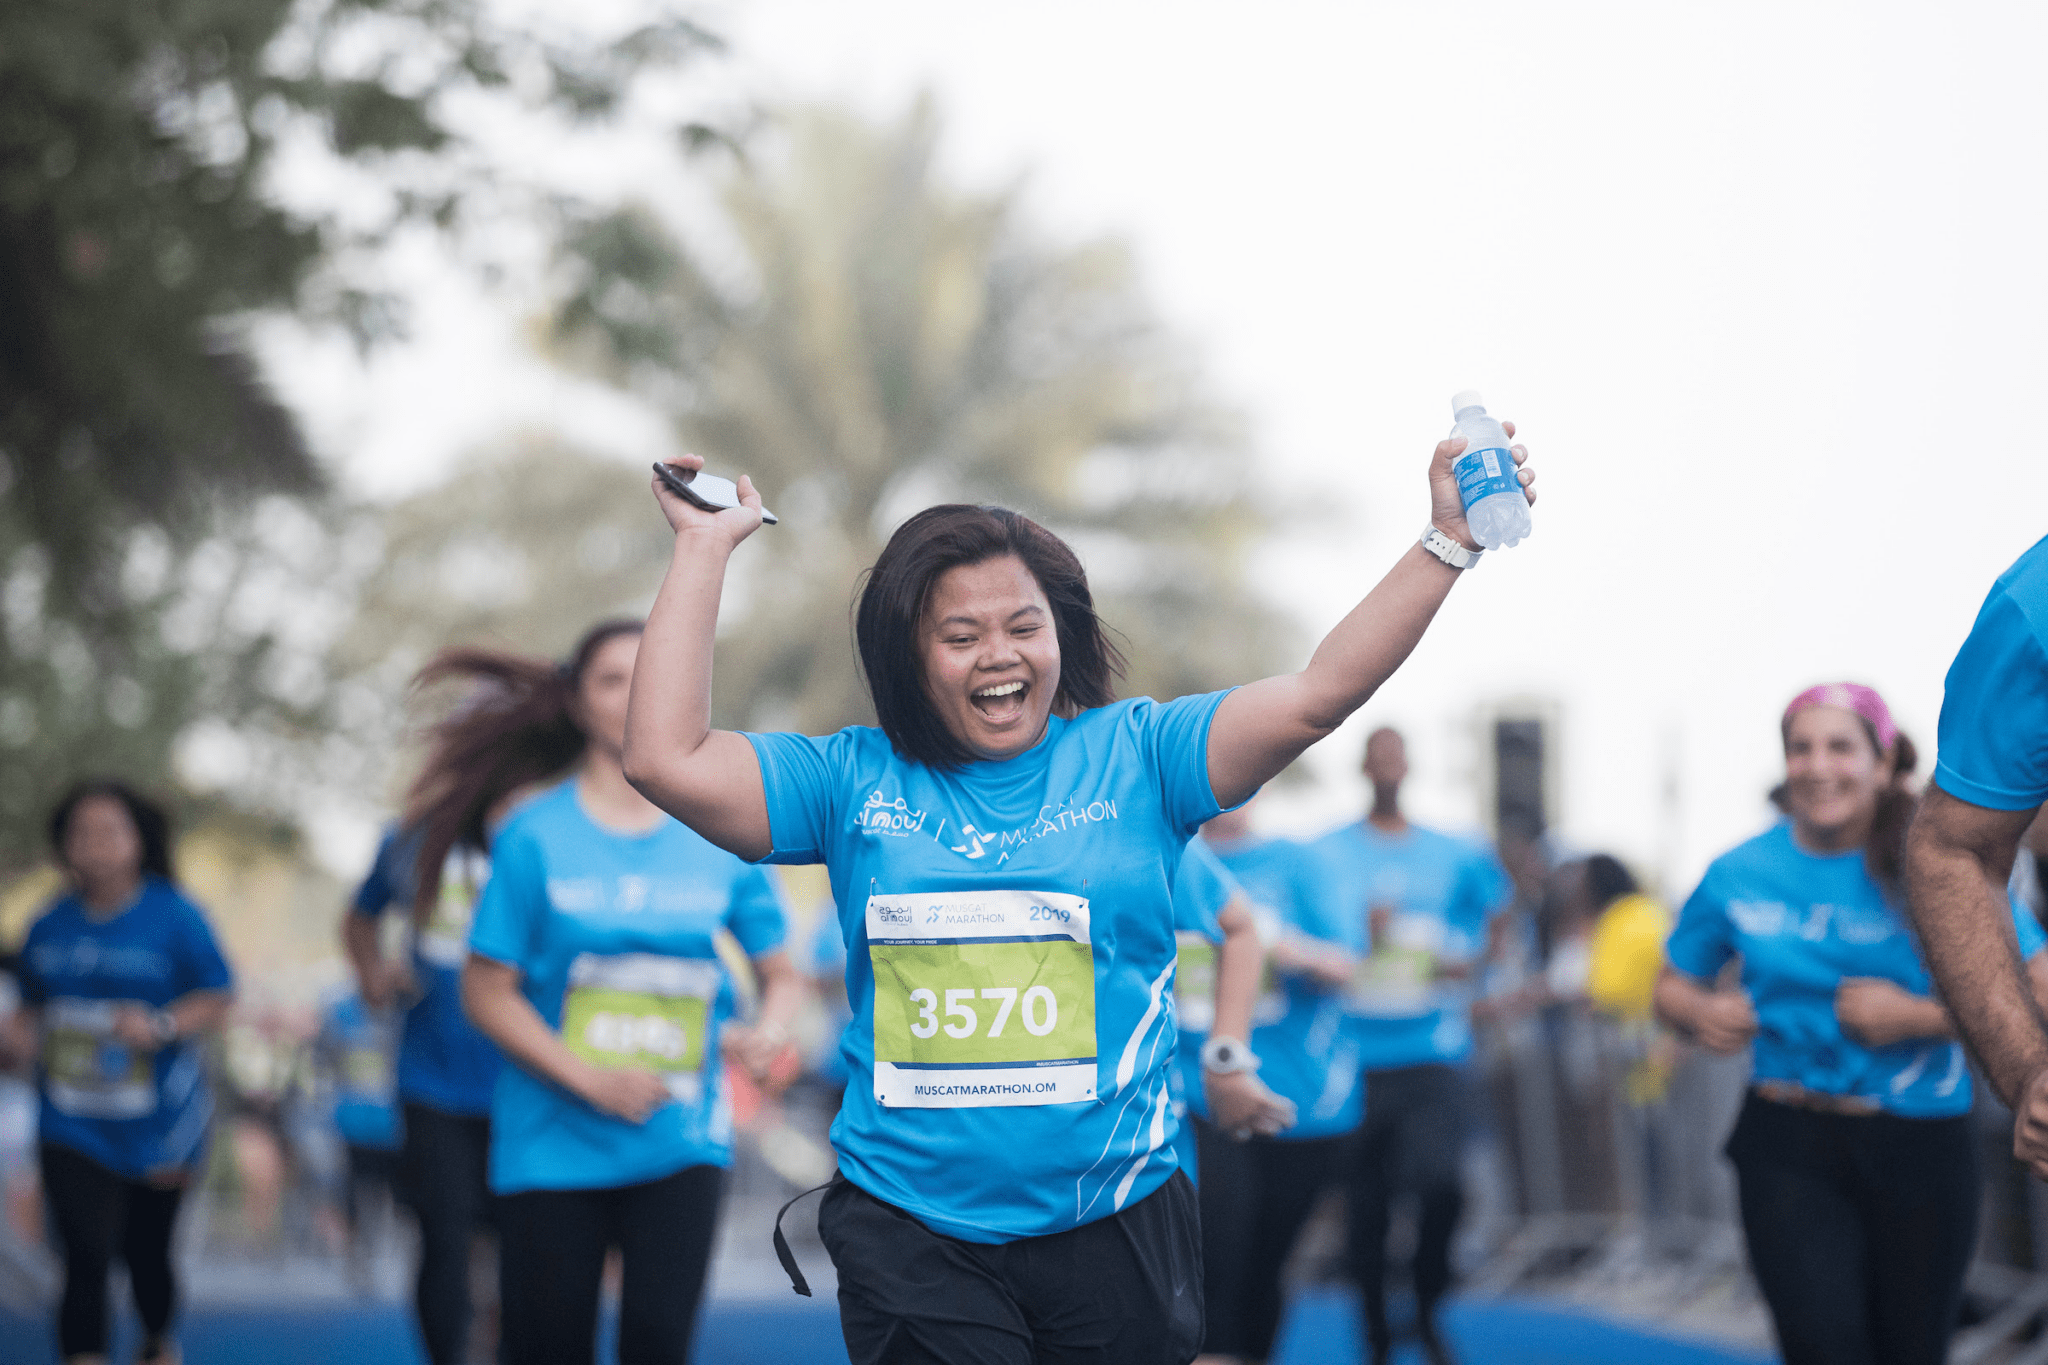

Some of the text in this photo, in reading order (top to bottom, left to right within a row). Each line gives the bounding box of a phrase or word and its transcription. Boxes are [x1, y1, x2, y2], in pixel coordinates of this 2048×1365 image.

[945, 903, 986, 914] MUSCAT
[1029, 905, 1071, 922] 2019
[945, 913, 1005, 924] MARATHON
[910, 985, 1058, 1039] 3570
[915, 1083, 1056, 1096] MUSCATMARATHON.OM
